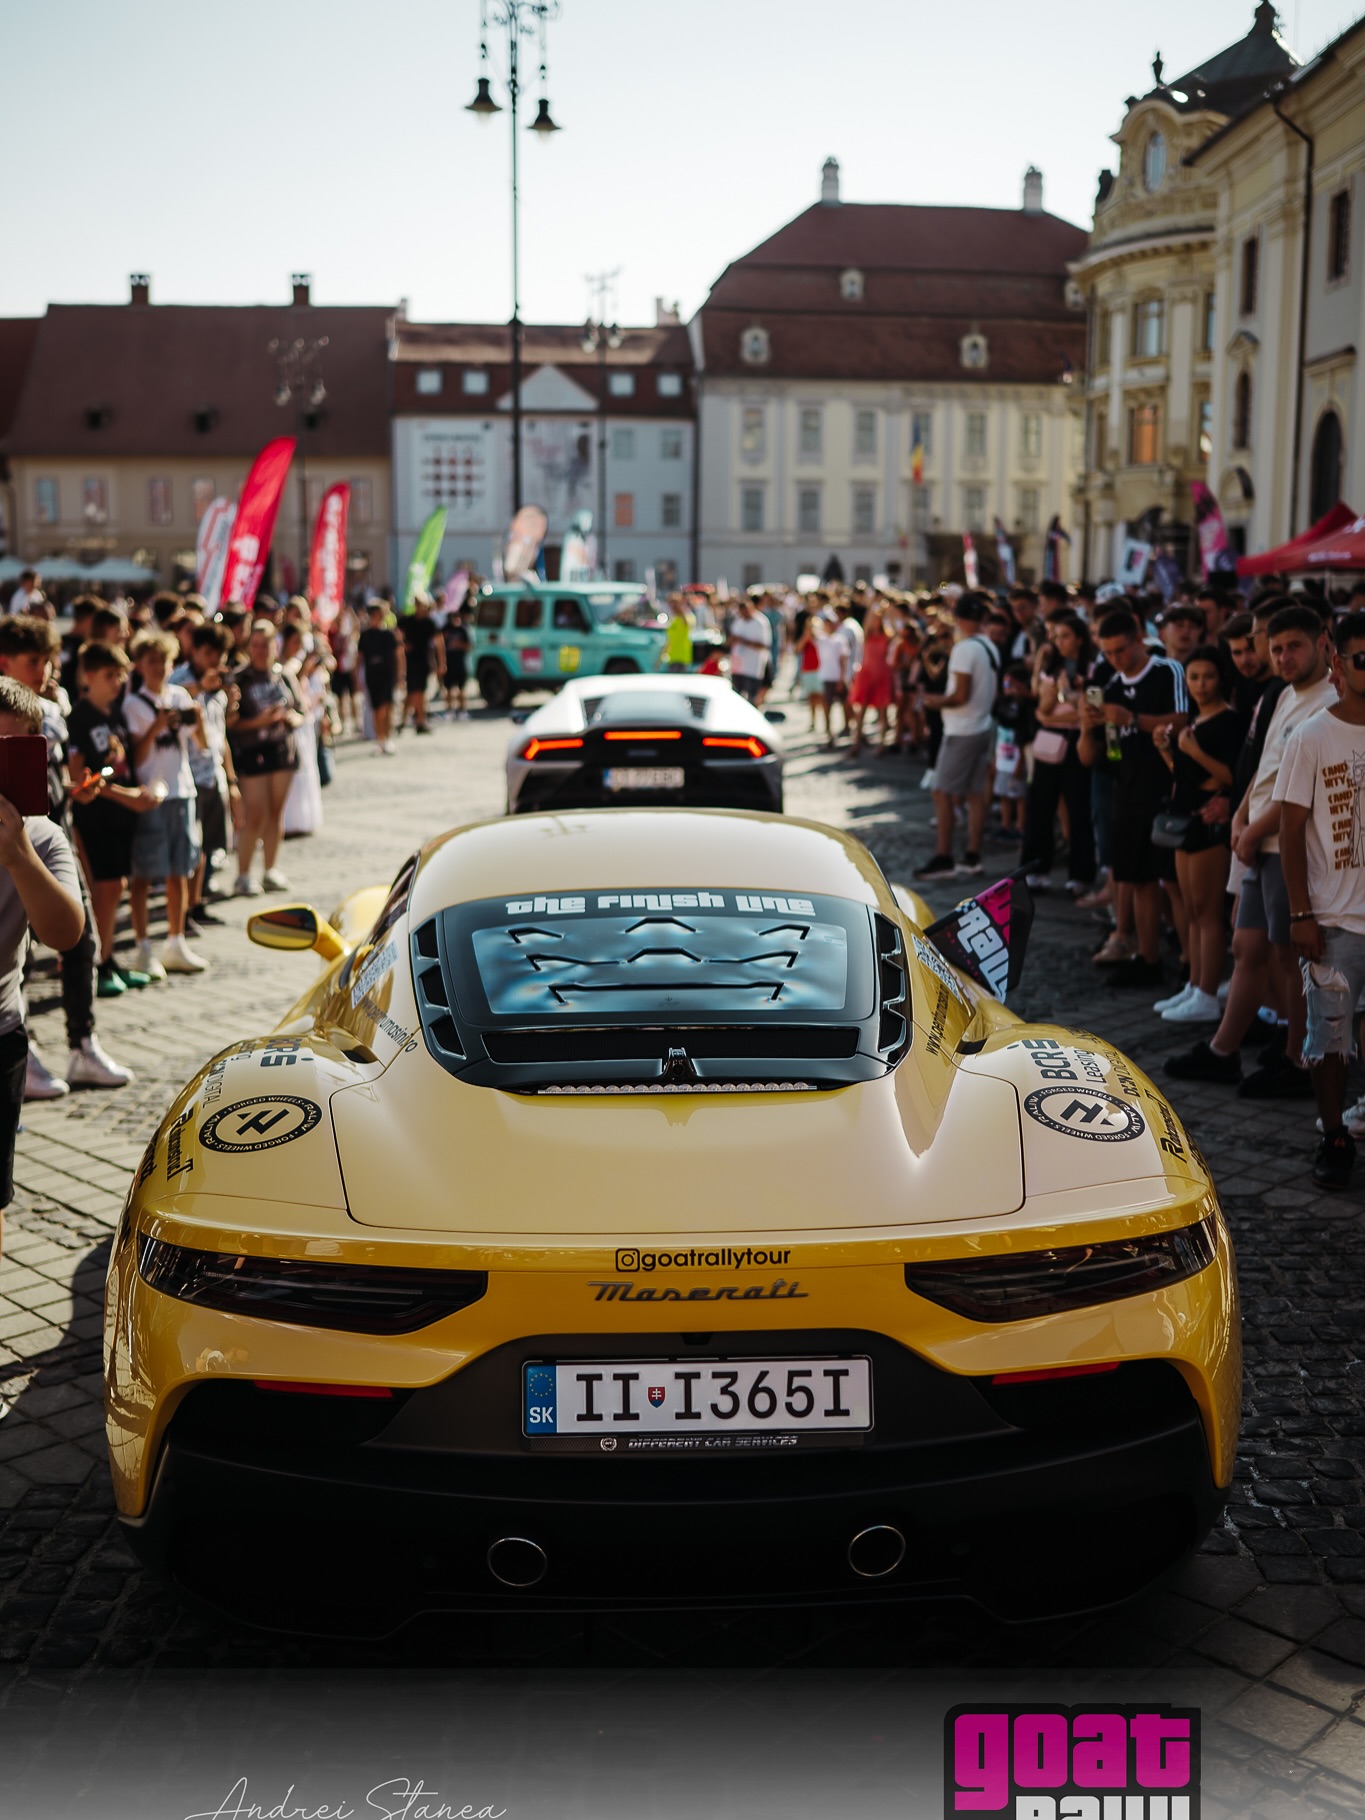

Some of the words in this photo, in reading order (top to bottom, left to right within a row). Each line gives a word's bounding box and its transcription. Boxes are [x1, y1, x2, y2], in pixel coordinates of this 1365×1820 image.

[1074, 1049, 1107, 1084] Leasing
[1041, 1086, 1075, 1096] FORGED
[1076, 1087, 1114, 1102] WHEELS
[227, 1096, 266, 1112] FORGED
[268, 1096, 304, 1105] WHEELS
[254, 1133, 296, 1150] FORGED
[641, 1248, 791, 1271] goatrallytour
[587, 1278, 809, 1302] Maserati
[529, 1406, 554, 1424] SK
[628, 1438, 702, 1448] DIFFERENT
[704, 1437, 732, 1448] CAR
[735, 1435, 799, 1447] SERVICES
